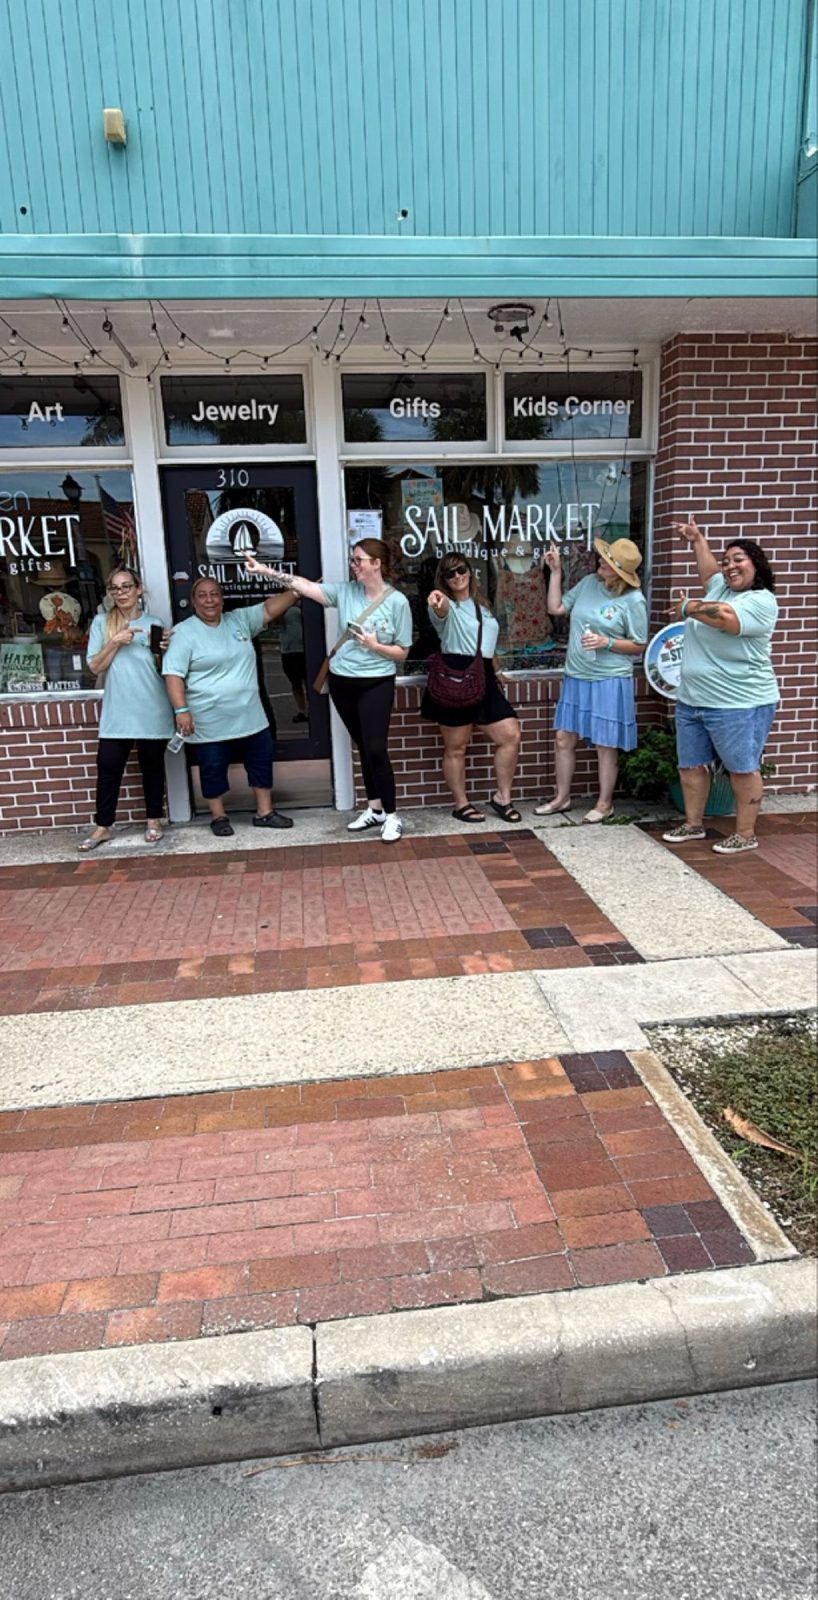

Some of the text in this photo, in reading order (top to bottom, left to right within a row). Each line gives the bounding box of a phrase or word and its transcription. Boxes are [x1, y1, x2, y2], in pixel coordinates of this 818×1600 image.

[27, 401, 64, 422] Art
[192, 399, 279, 425] Jewelry
[389, 397, 441, 418] Gifts
[513, 396, 634, 417] Kids Corner
[216, 469, 249, 487] 310
[400, 503, 600, 558] SAIL MARKET
[515, 546, 525, 556] &
[9, 557, 52, 576] gifts
[4, 653, 41, 666] HAPPY
